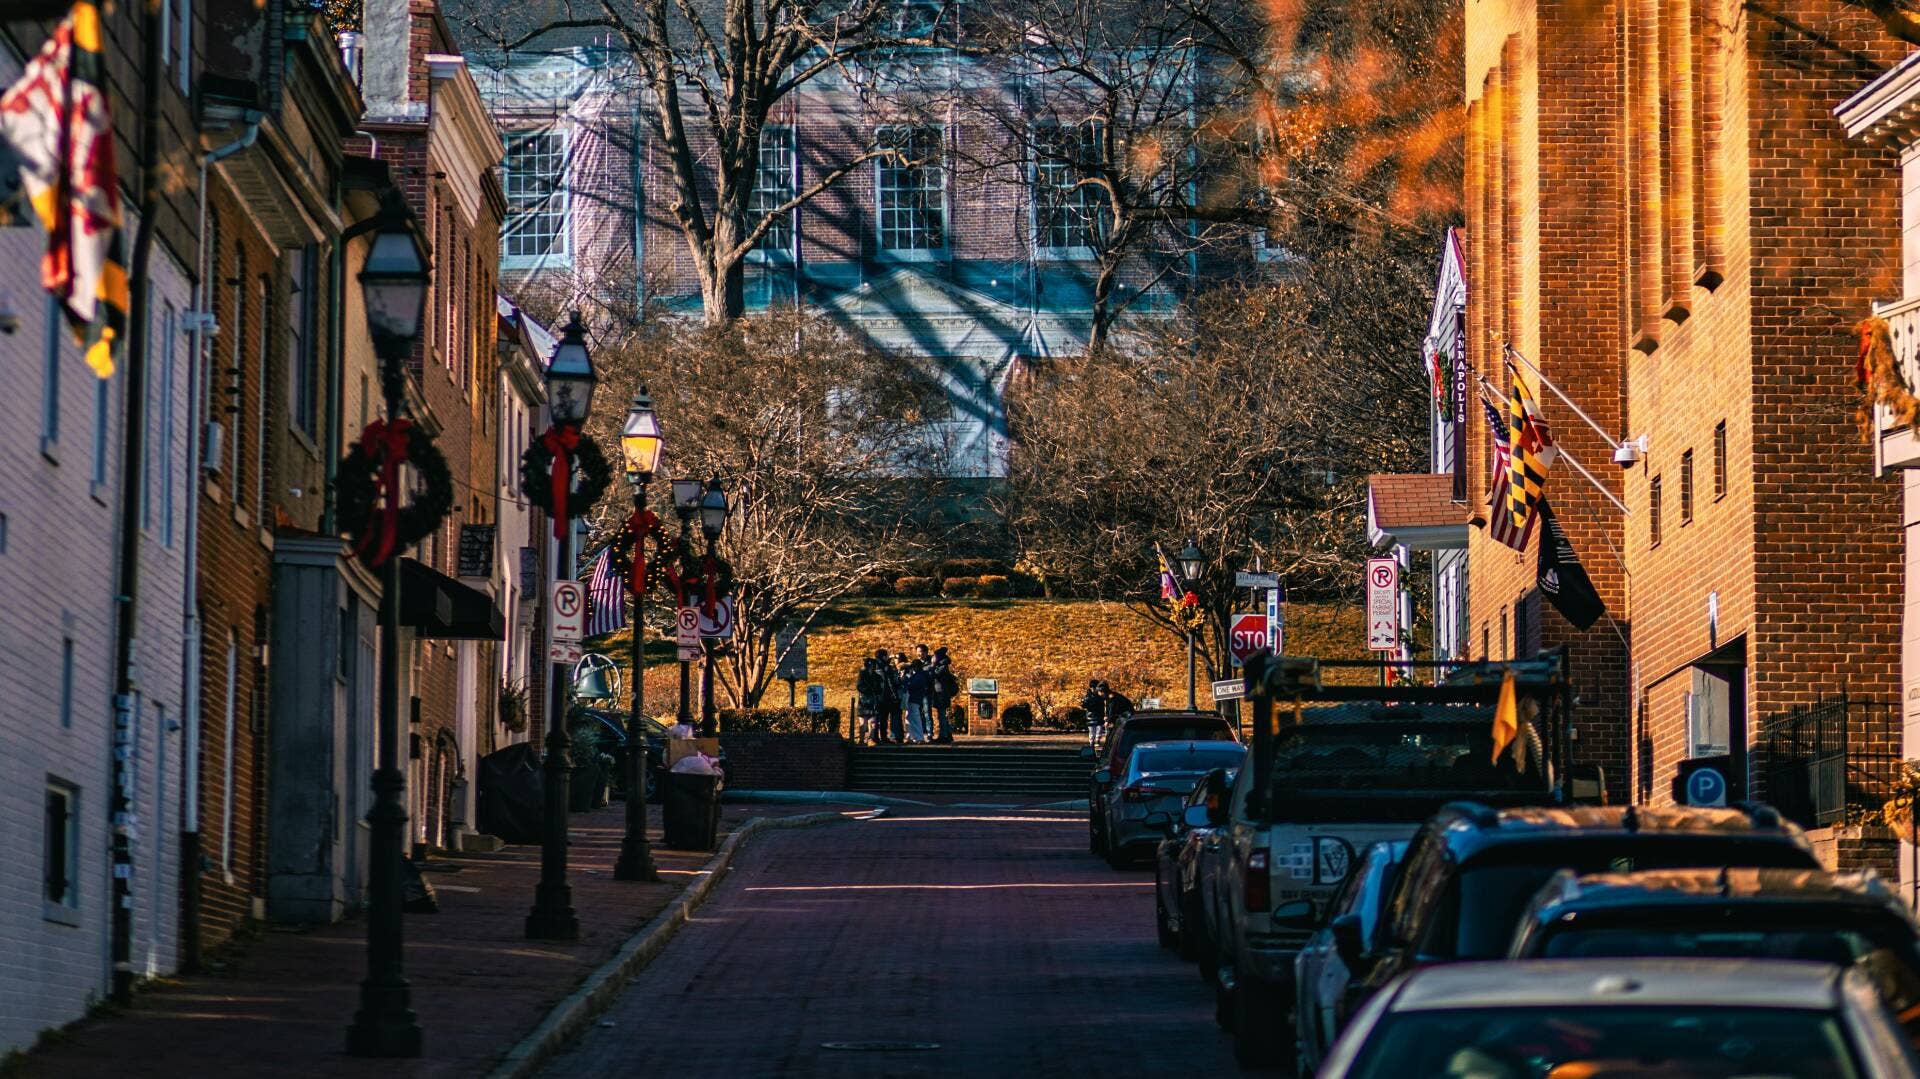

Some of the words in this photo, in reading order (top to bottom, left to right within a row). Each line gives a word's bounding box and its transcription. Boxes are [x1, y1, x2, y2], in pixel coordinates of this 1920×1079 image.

[1457, 329, 1465, 423] ANNAPOLIS
[1233, 630, 1266, 650] STO
[1218, 686, 1230, 695] ONE
[1700, 777, 1714, 798] P
